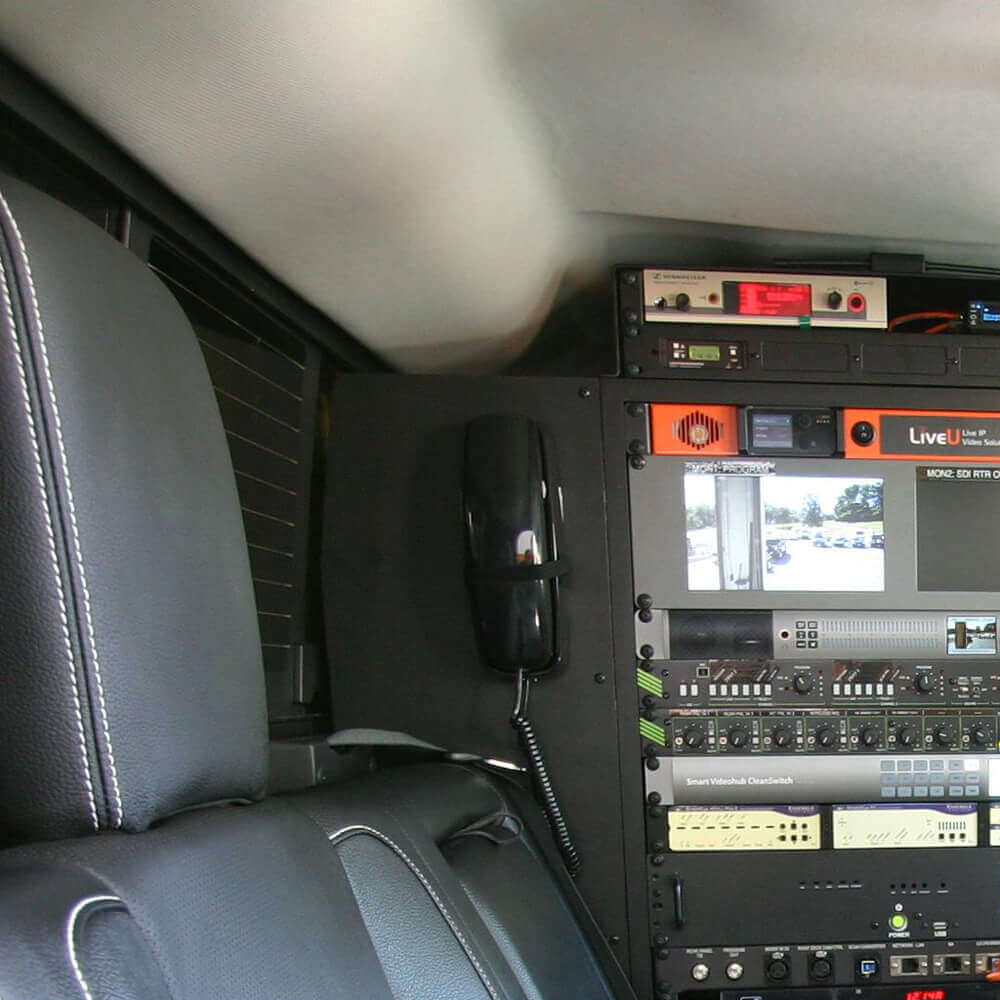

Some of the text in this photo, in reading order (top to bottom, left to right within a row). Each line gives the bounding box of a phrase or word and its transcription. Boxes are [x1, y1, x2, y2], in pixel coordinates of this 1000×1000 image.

[909, 425, 961, 446] LiveU
[687, 776, 794, 786] Smart Videohub CleanSwitch
